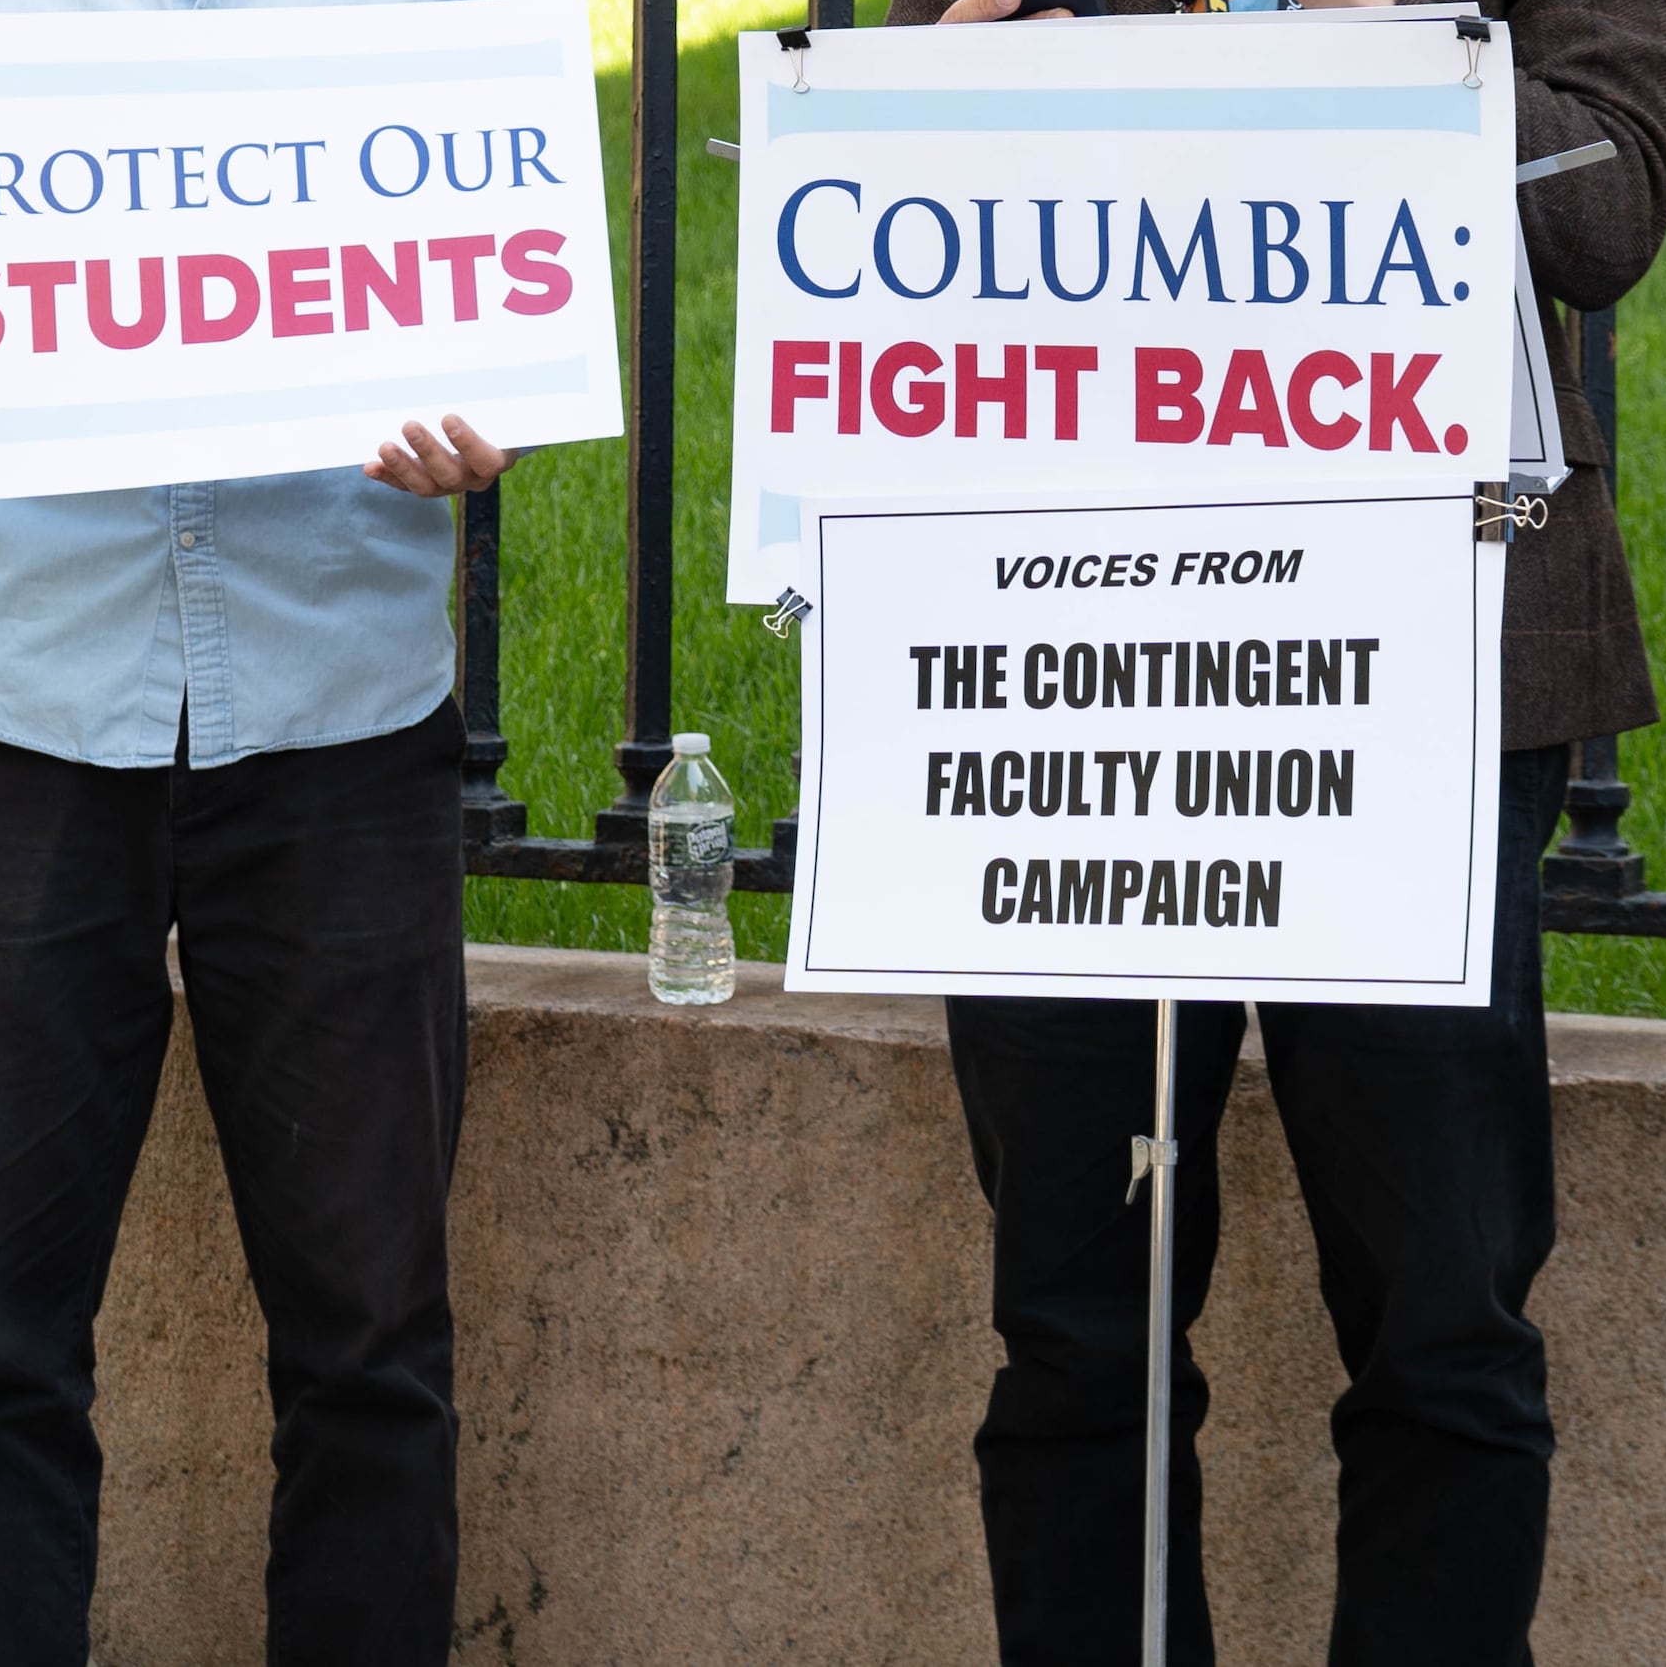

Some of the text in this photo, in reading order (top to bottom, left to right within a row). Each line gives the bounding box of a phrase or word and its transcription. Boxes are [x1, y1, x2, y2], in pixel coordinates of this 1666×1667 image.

[359, 124, 566, 198] OUR
[776, 178, 1471, 308] COLUMBIA:
[770, 339, 1469, 456] FIGHT BACK.
[995, 548, 1304, 590] VOICES FROM
[909, 637, 1380, 710] THE CONTINGENT
[926, 748, 1354, 818] FACULTY UNION
[981, 857, 1282, 928] CAMPAIGN
